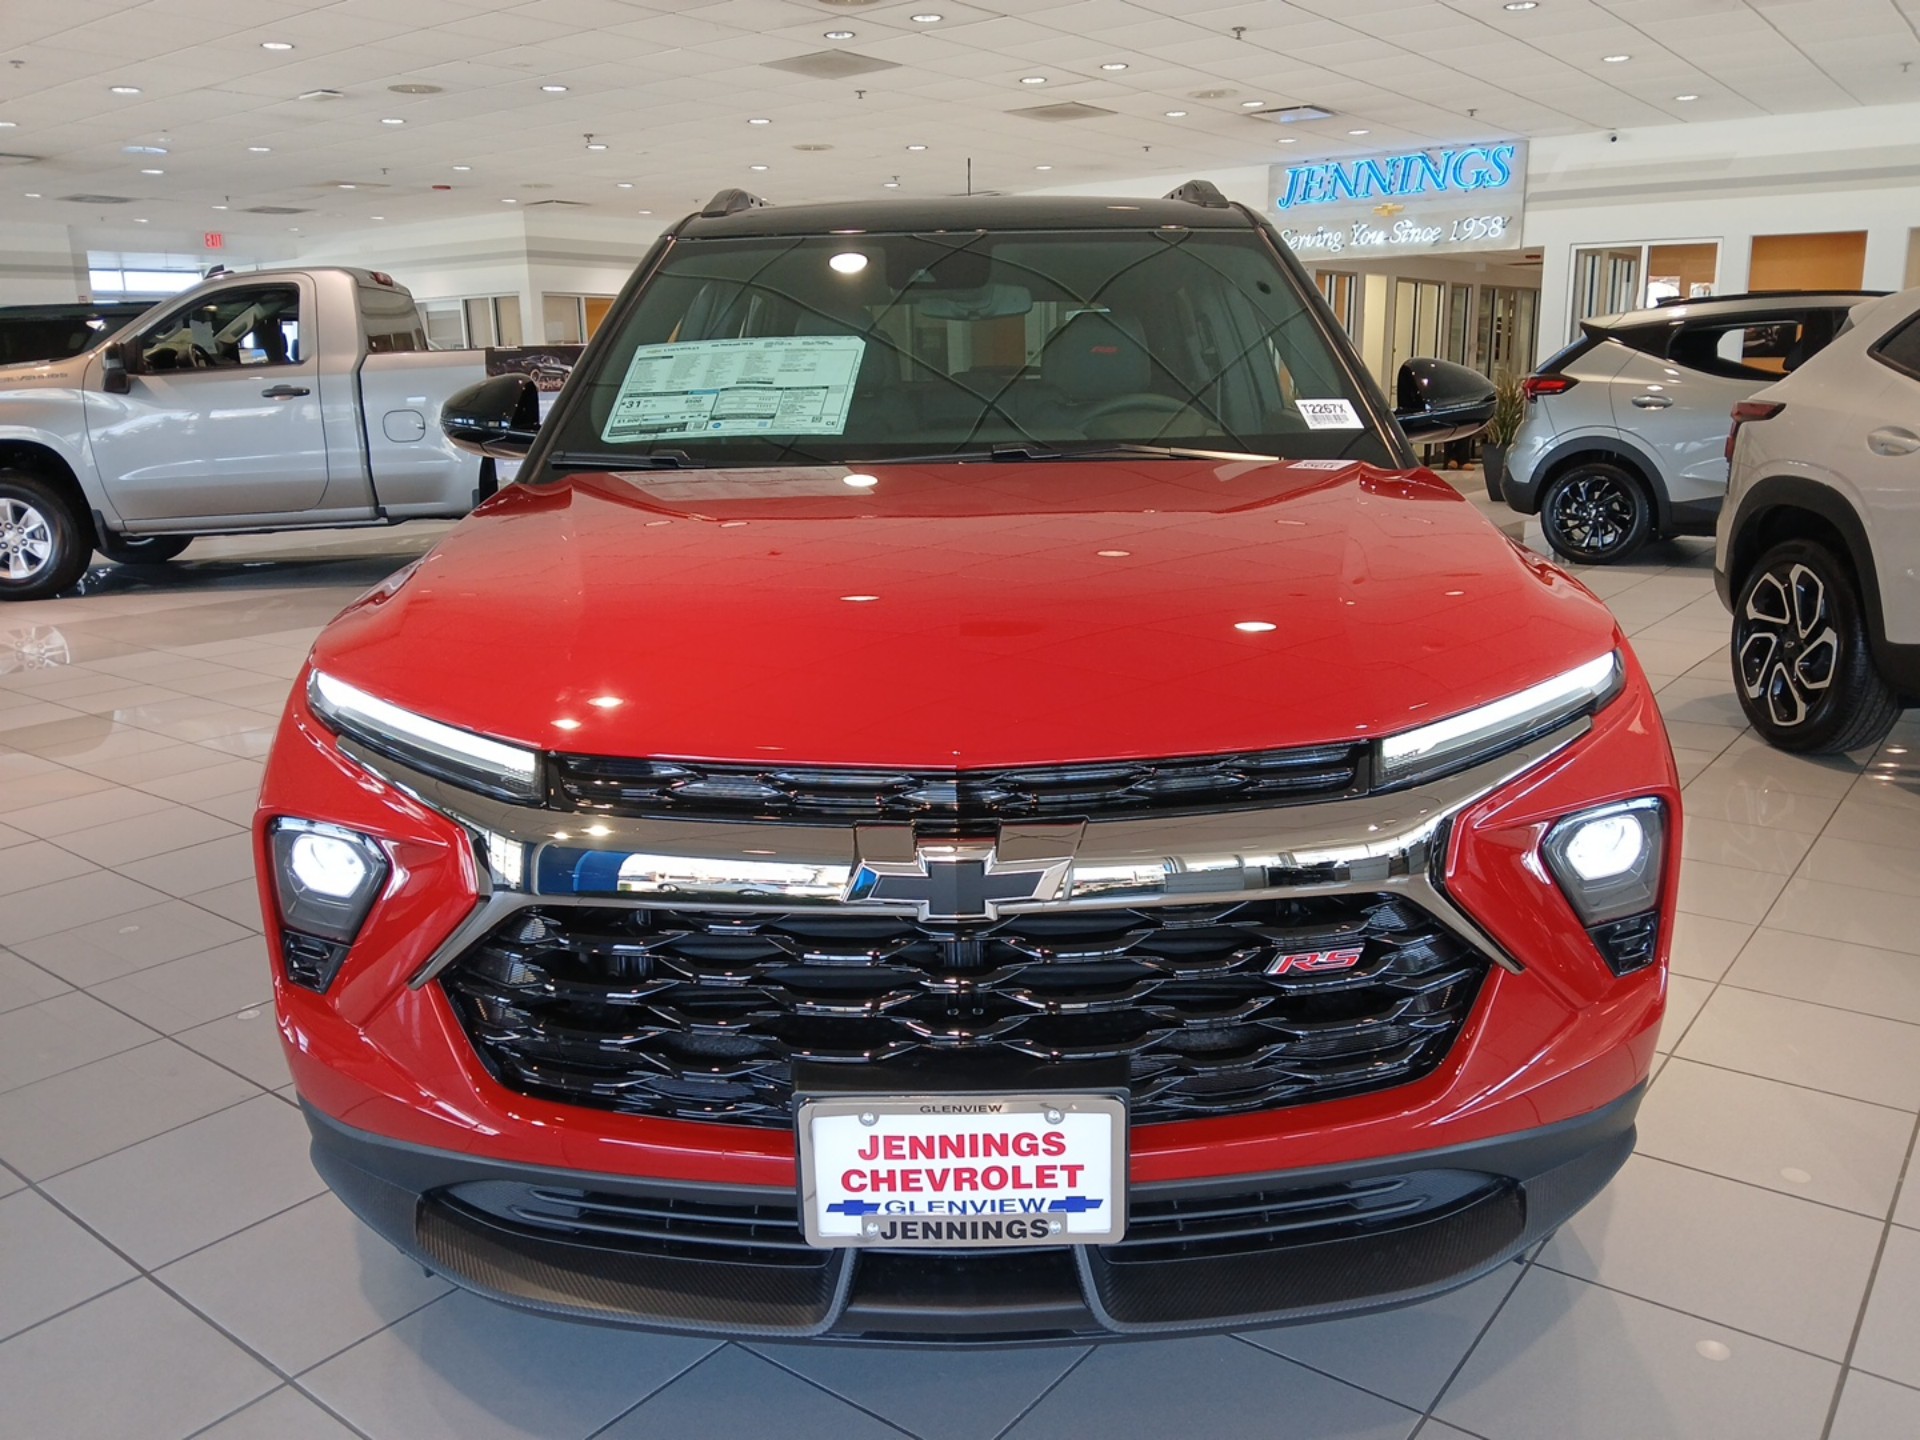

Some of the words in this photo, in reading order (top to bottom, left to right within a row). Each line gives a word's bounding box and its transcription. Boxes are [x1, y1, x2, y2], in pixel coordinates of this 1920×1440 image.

[1277, 146, 1514, 209] JENNINGS
[1281, 226, 1344, 252] Serving
[1351, 223, 1385, 246] You
[1388, 219, 1441, 244] Since
[1448, 216, 1504, 241] 1958
[1301, 403, 1347, 414] T2267X
[1268, 947, 1364, 975] RS
[920, 1104, 1002, 1113] GLENVIEW
[858, 1131, 1066, 1161] JENNINGS
[841, 1164, 1085, 1192] CHEVROLET
[884, 1197, 1047, 1215] GLENVIEW
[880, 1218, 1050, 1240] JENNINGS
